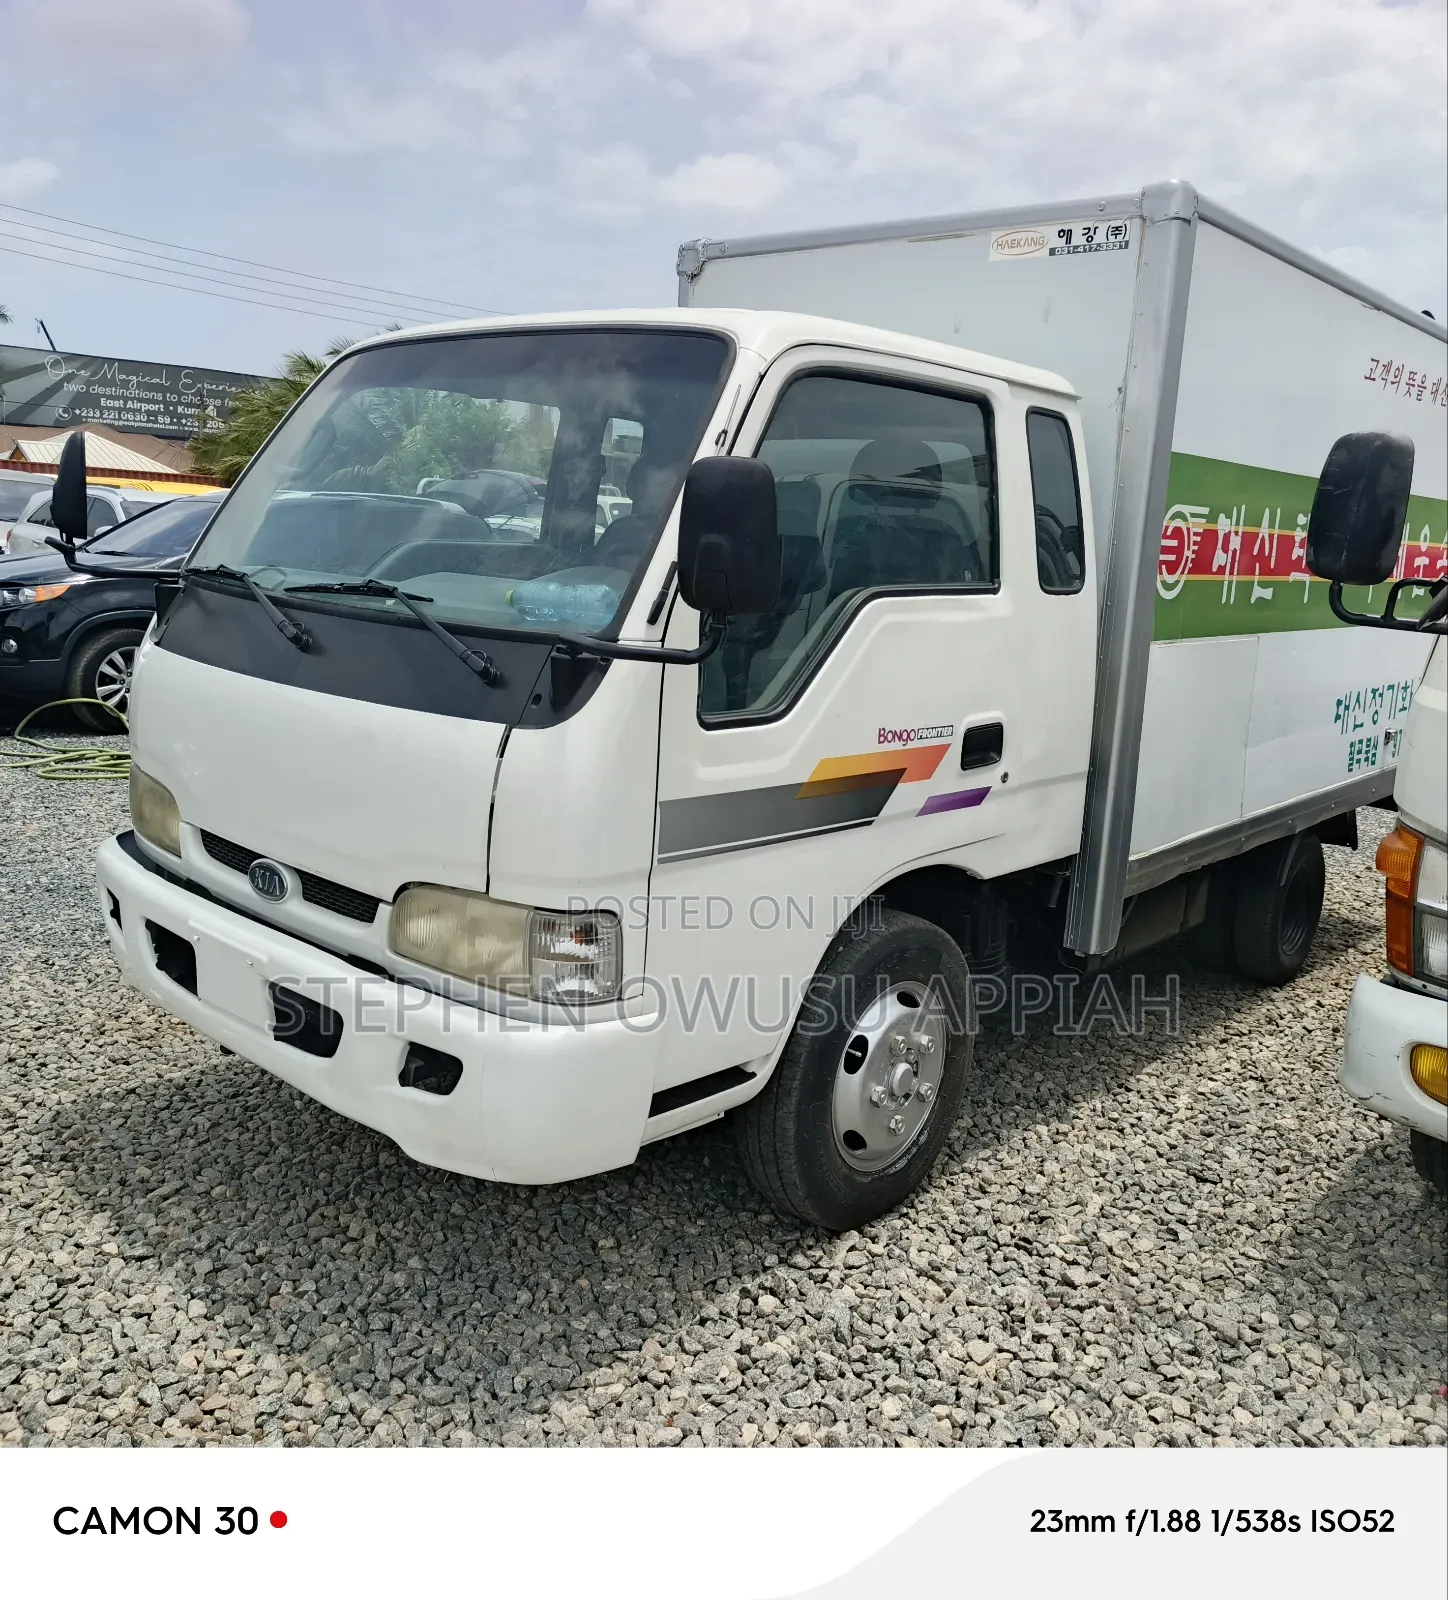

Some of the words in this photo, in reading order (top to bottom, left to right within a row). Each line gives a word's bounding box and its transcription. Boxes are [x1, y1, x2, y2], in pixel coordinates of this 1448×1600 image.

[995, 236, 1046, 251] HAEKANG
[1057, 228, 1073, 246] 해
[1082, 226, 1099, 244] 강
[1055, 241, 1126, 256] 031-417-3331
[45, 355, 91, 380] One
[90, 361, 171, 390] Magical
[1364, 357, 1405, 395] 고객의
[1403, 370, 1427, 402] 뜻을
[63, 381, 86, 393] two
[89, 384, 163, 401] destinations
[166, 392, 178, 402] to
[74, 407, 100, 418] +233
[102, 409, 119, 420] 221
[120, 411, 148, 422] 0630
[181, 417, 200, 427] +23
[100, 397, 125, 409] East
[126, 400, 165, 412] Airport
[177, 405, 217, 417] Kumsi
[1333, 679, 1414, 735] 대신정기화
[917, 726, 953, 740] FRONTIER
[254, 867, 280, 896] KIA
